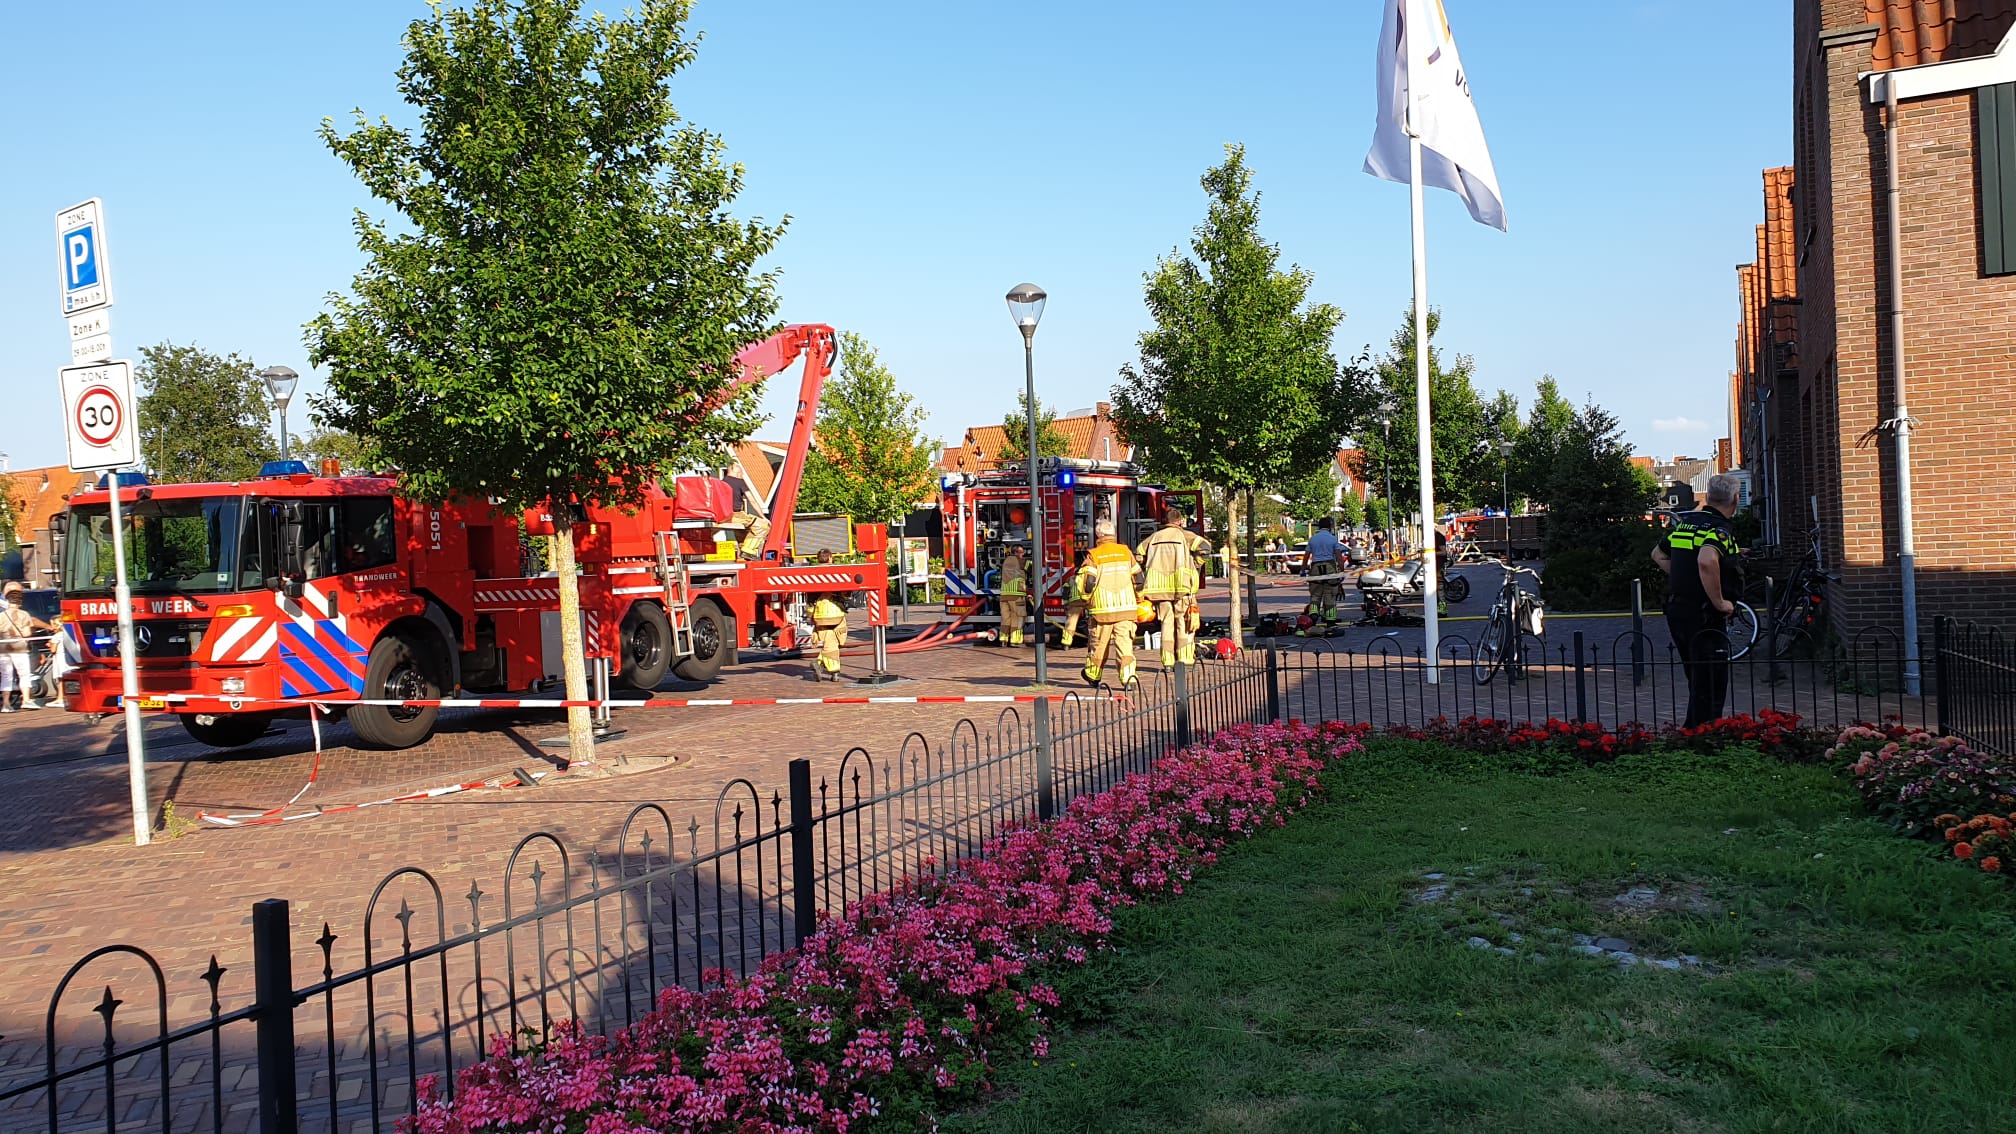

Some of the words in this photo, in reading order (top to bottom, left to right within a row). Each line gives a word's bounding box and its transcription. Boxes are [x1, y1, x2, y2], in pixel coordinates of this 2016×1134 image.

[67, 210, 86, 226] ZONE
[68, 234, 90, 284] P
[72, 323, 93, 336] Zone
[80, 370, 110, 383] ZONE
[85, 405, 114, 427] 30
[354, 572, 397, 582] BRANDWEER
[80, 602, 118, 616] BRAN
[151, 600, 193, 614] WEER
